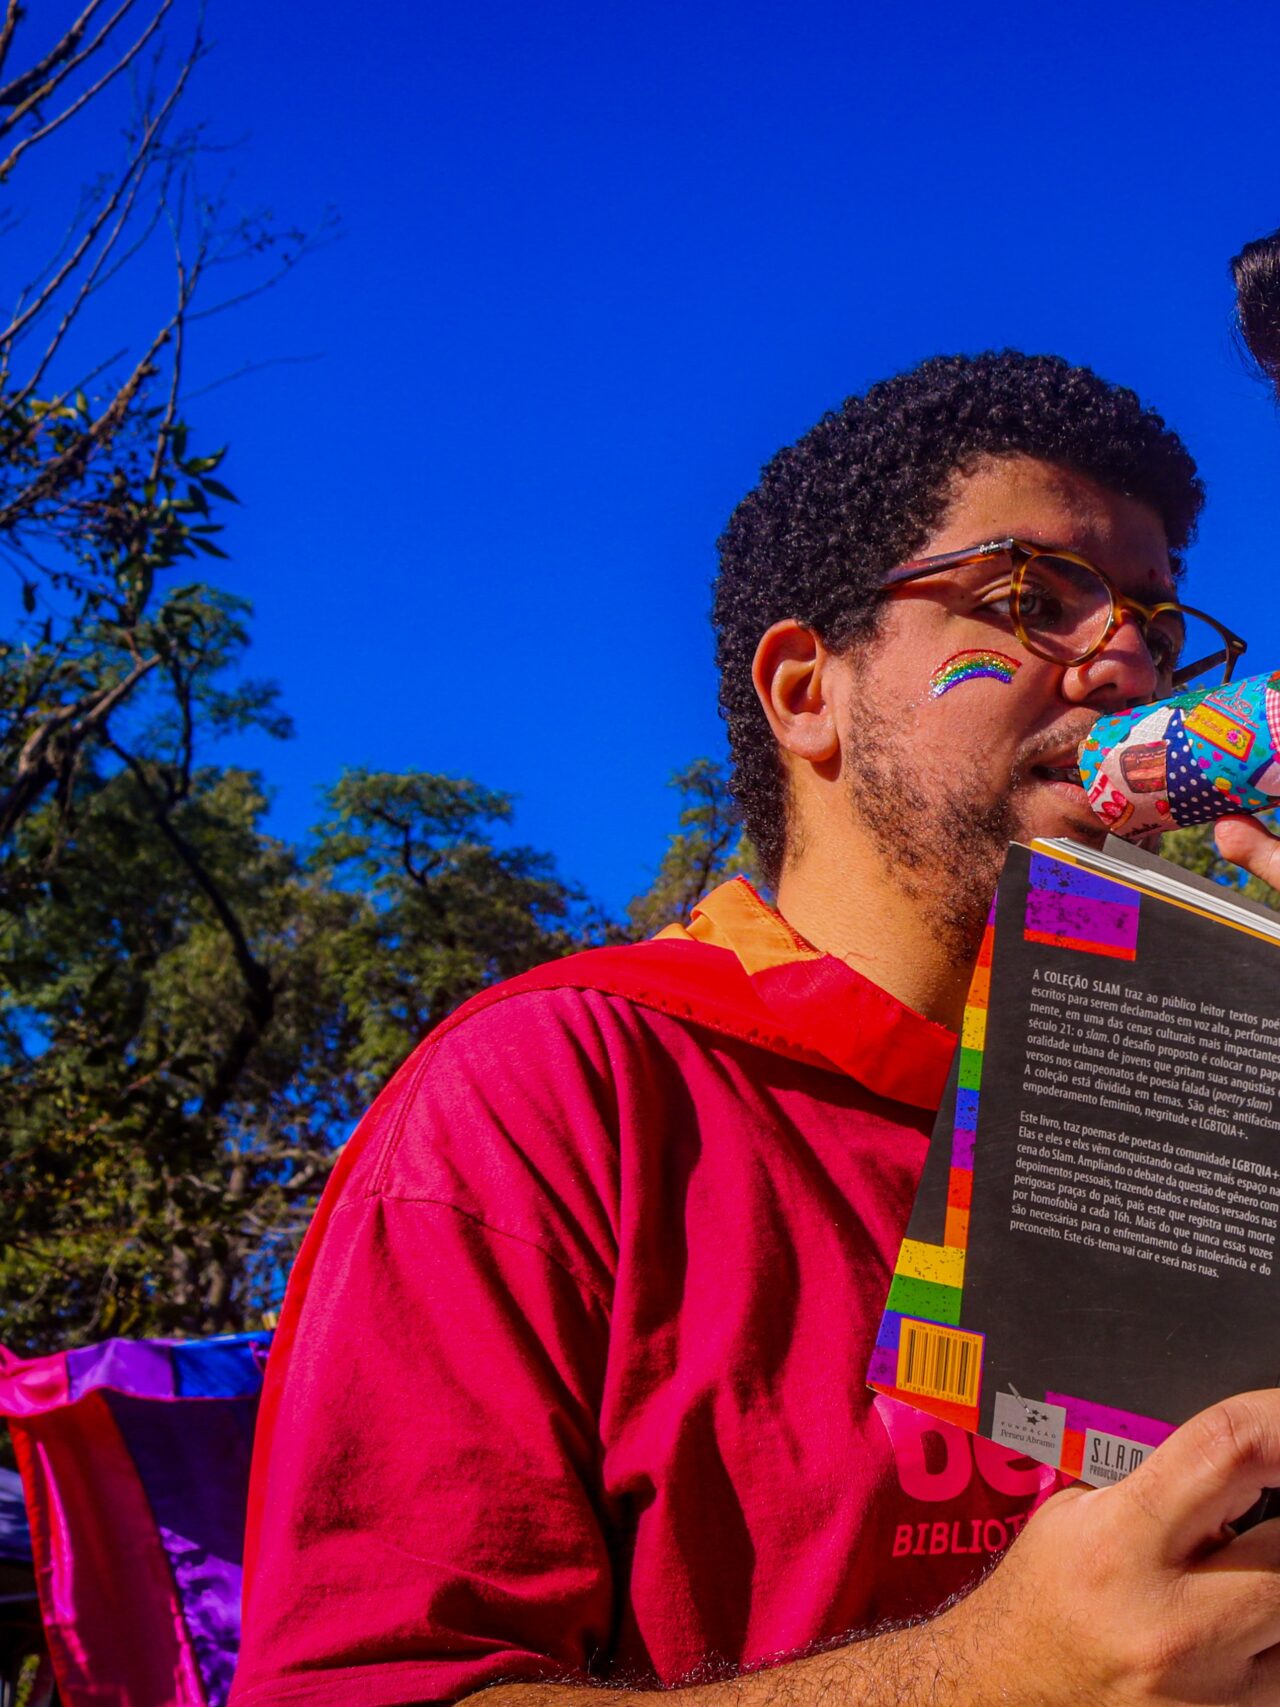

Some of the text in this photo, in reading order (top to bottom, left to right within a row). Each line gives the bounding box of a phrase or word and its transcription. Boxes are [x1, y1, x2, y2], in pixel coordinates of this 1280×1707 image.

[1031, 987, 1065, 1001] escritos
[1067, 994, 1088, 1006] para
[1090, 998, 1118, 1012] serem
[1120, 1002, 1175, 1024] declamados
[1176, 1016, 1192, 1027] em
[1194, 1020, 1210, 1031] voz
[1211, 1022, 1232, 1037] alta,
[1032, 968, 1039, 980] A
[1043, 970, 1088, 989] COLEÇÃO
[1092, 980, 1120, 995] SLAM
[1124, 988, 1143, 1000] traz
[1146, 993, 1158, 1003] ao
[1161, 995, 1196, 1011] público
[1200, 1001, 1225, 1017] leitor
[1229, 1009, 1258, 1025] textos
[1028, 1017, 1057, 1032] século
[1059, 1022, 1074, 1036] 21:
[1076, 1028, 1083, 1037] o
[1085, 1028, 1109, 1043] slam.
[1112, 1033, 1120, 1045] O
[1122, 1035, 1155, 1052] desafio
[1157, 1045, 1199, 1061] proposto
[1201, 1052, 1207, 1064] é
[1209, 1056, 1243, 1071] colocar
[1245, 1064, 1258, 1075] no
[1029, 1003, 1062, 1018] mente,
[1065, 1010, 1080, 1020] em
[1083, 1013, 1104, 1025] uma
[1107, 1016, 1123, 1029] das
[1126, 1022, 1152, 1035] cenas
[1155, 1027, 1195, 1044] culturais
[1198, 1037, 1221, 1050] mais
[1224, 1040, 1280, 1064] impactantes
[1024, 1063, 1031, 1075] A
[1034, 1067, 1068, 1083] coleção
[1071, 1076, 1091, 1087] está
[1094, 1078, 1131, 1096] dividida
[1134, 1089, 1149, 1100] em
[1153, 1092, 1183, 1108] temas.
[1187, 1098, 1204, 1112] São
[1207, 1104, 1229, 1118] eles:
[1025, 1050, 1054, 1063] versos
[1055, 1056, 1072, 1067] nos
[1073, 1060, 1134, 1080] campeonatos
[1136, 1071, 1148, 1083] de
[1149, 1076, 1179, 1090] poesia
[1181, 1080, 1210, 1097] falada
[1212, 1088, 1246, 1107] (poetry
[1026, 1034, 1070, 1051] oralidade
[1072, 1043, 1104, 1058] urbana
[1107, 1048, 1119, 1061] de
[1121, 1051, 1151, 1068] jovens
[1153, 1061, 1171, 1072] que
[1173, 1065, 1205, 1080] gritam
[1207, 1072, 1228, 1085] suas
[1230, 1078, 1275, 1096] angústias
[1020, 1110, 1038, 1124] Este
[1039, 1114, 1061, 1130] livro,
[1063, 1120, 1080, 1133] traz
[1081, 1126, 1116, 1141] poemas
[1118, 1131, 1130, 1144] de
[1130, 1136, 1161, 1151] poetas
[1162, 1141, 1174, 1154] da
[1175, 1147, 1230, 1167] comunidade
[1022, 1081, 1248, 1140] empoderamento feminino, negritude e LGBTQIA+.
[1016, 1144, 1279, 1212] cena do Slam. Ampliando o debate da questão de gênero com
[1018, 1125, 1280, 1197] Elas e eles e elxs vêm conquistando cada vez mais espaço na
[1014, 1174, 1275, 1244] perigosas praças do país, país este que registra uma morte
[1015, 1157, 1277, 1228] depoimentos pessoais, trazendo dados e relatos versados nas
[1009, 1220, 1219, 1278] preconceito. Este cis-tema vai cair e será nas ruas.
[1011, 1203, 1271, 1276] são necessárias para o enfrentamento da intolerância e do
[1012, 1189, 1273, 1260] por homofobia a cada 16h. Mais do que nunca essas vozes
[1026, 1434, 1056, 1449] Abramo
